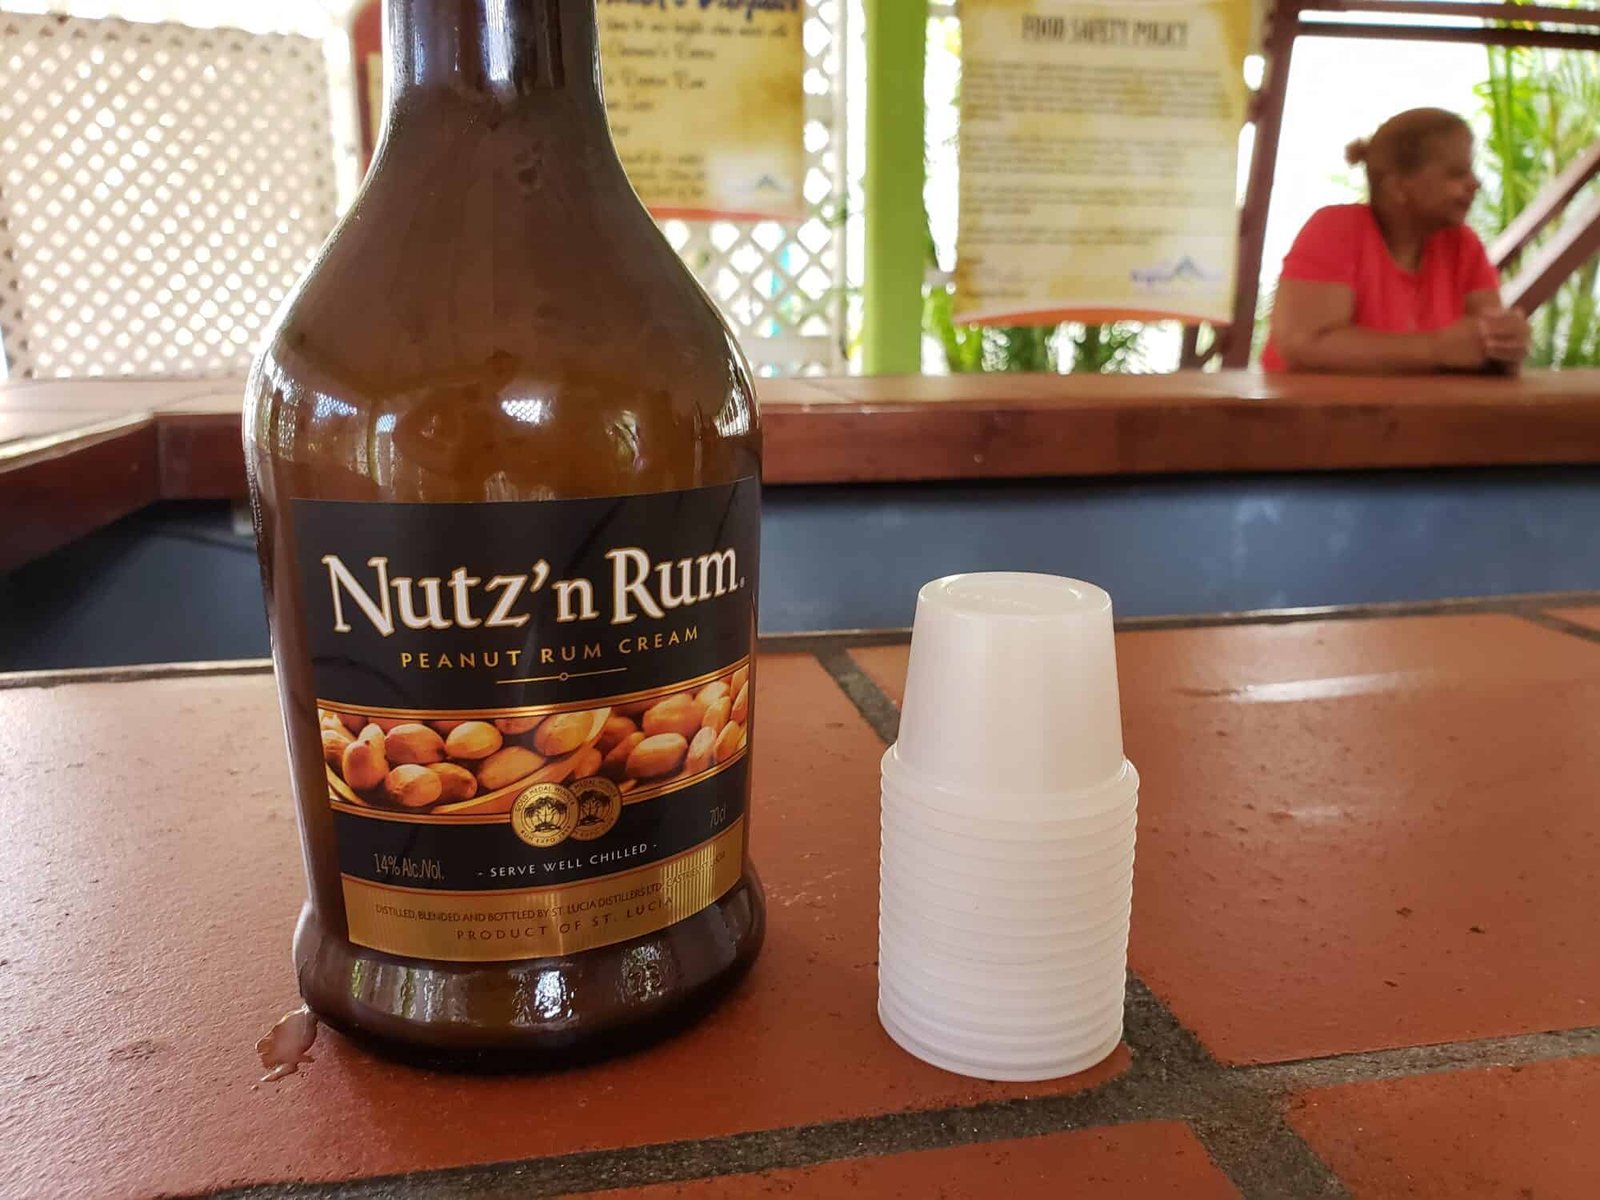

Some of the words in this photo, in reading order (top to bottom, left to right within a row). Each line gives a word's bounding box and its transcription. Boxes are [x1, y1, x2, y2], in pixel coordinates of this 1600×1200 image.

[400, 649, 522, 669] PEANUT
[540, 643, 602, 664] RUM
[618, 625, 698, 655] CREAM
[709, 804, 727, 828] 70cl
[373, 852, 401, 876] 14%
[490, 863, 536, 878] SERVE
[543, 857, 583, 873] WELL
[589, 843, 648, 865] CHILLED
[418, 911, 461, 923] BLENDED
[462, 911, 486, 922] AND
[487, 909, 536, 922] BOTTLED
[536, 908, 549, 919] BY
[567, 900, 597, 915] LUCIA
[456, 926, 548, 941] PRODUCT
[559, 920, 582, 935] OF
[592, 914, 618, 927] ST.
[626, 896, 673, 918] LUCIA
